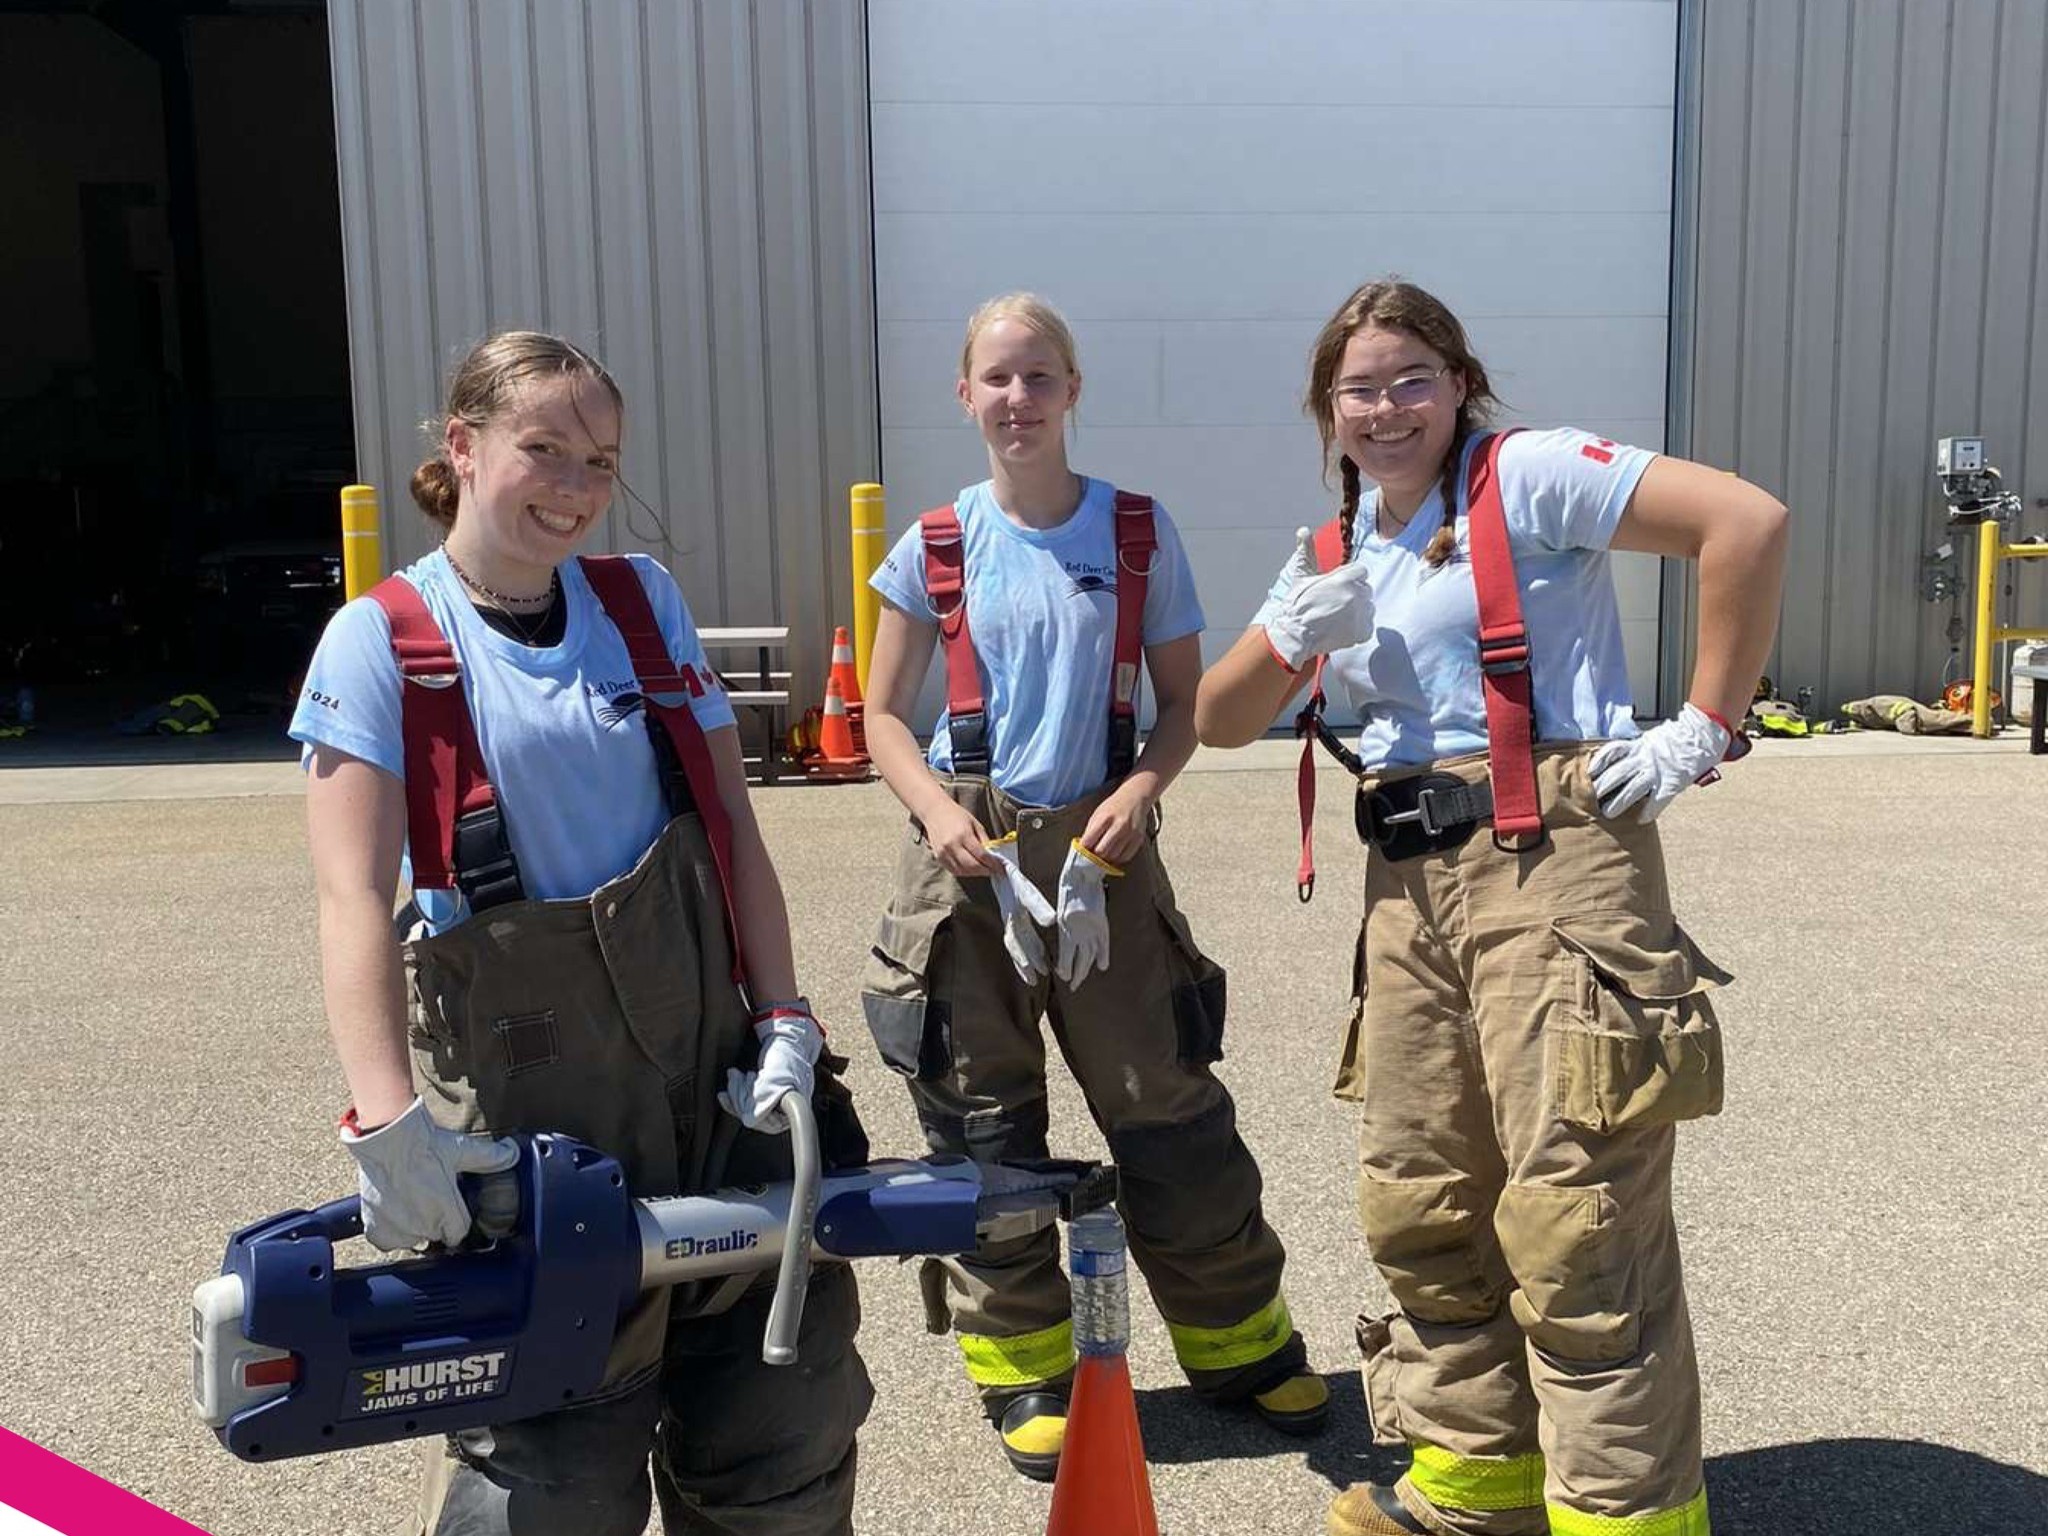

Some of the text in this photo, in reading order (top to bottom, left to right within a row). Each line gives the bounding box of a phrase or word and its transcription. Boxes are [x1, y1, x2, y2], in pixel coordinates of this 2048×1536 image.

[665, 1229, 758, 1260] EDraulic
[385, 1351, 505, 1393] HURST
[361, 1380, 495, 1412] JAWS OF LIFE
